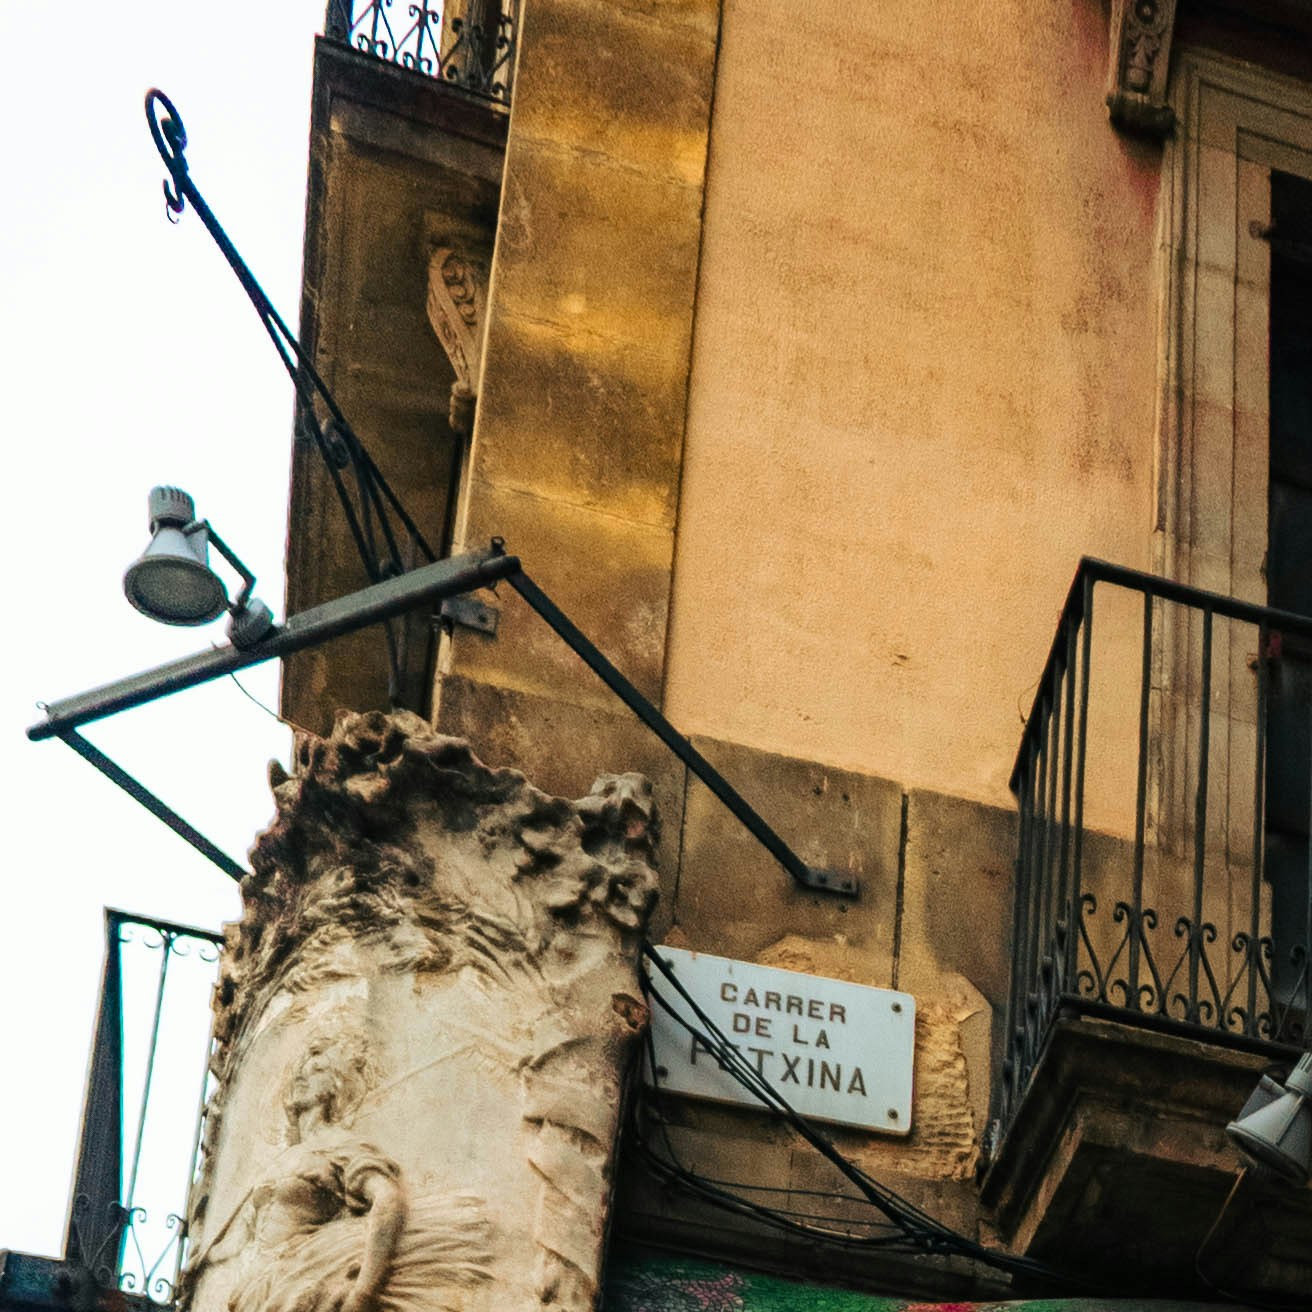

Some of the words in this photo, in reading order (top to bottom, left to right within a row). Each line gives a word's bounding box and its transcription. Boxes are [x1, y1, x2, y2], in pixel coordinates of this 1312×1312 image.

[719, 982, 848, 1024] CARRER
[732, 1012, 773, 1039] DE
[792, 1021, 831, 1050] LA
